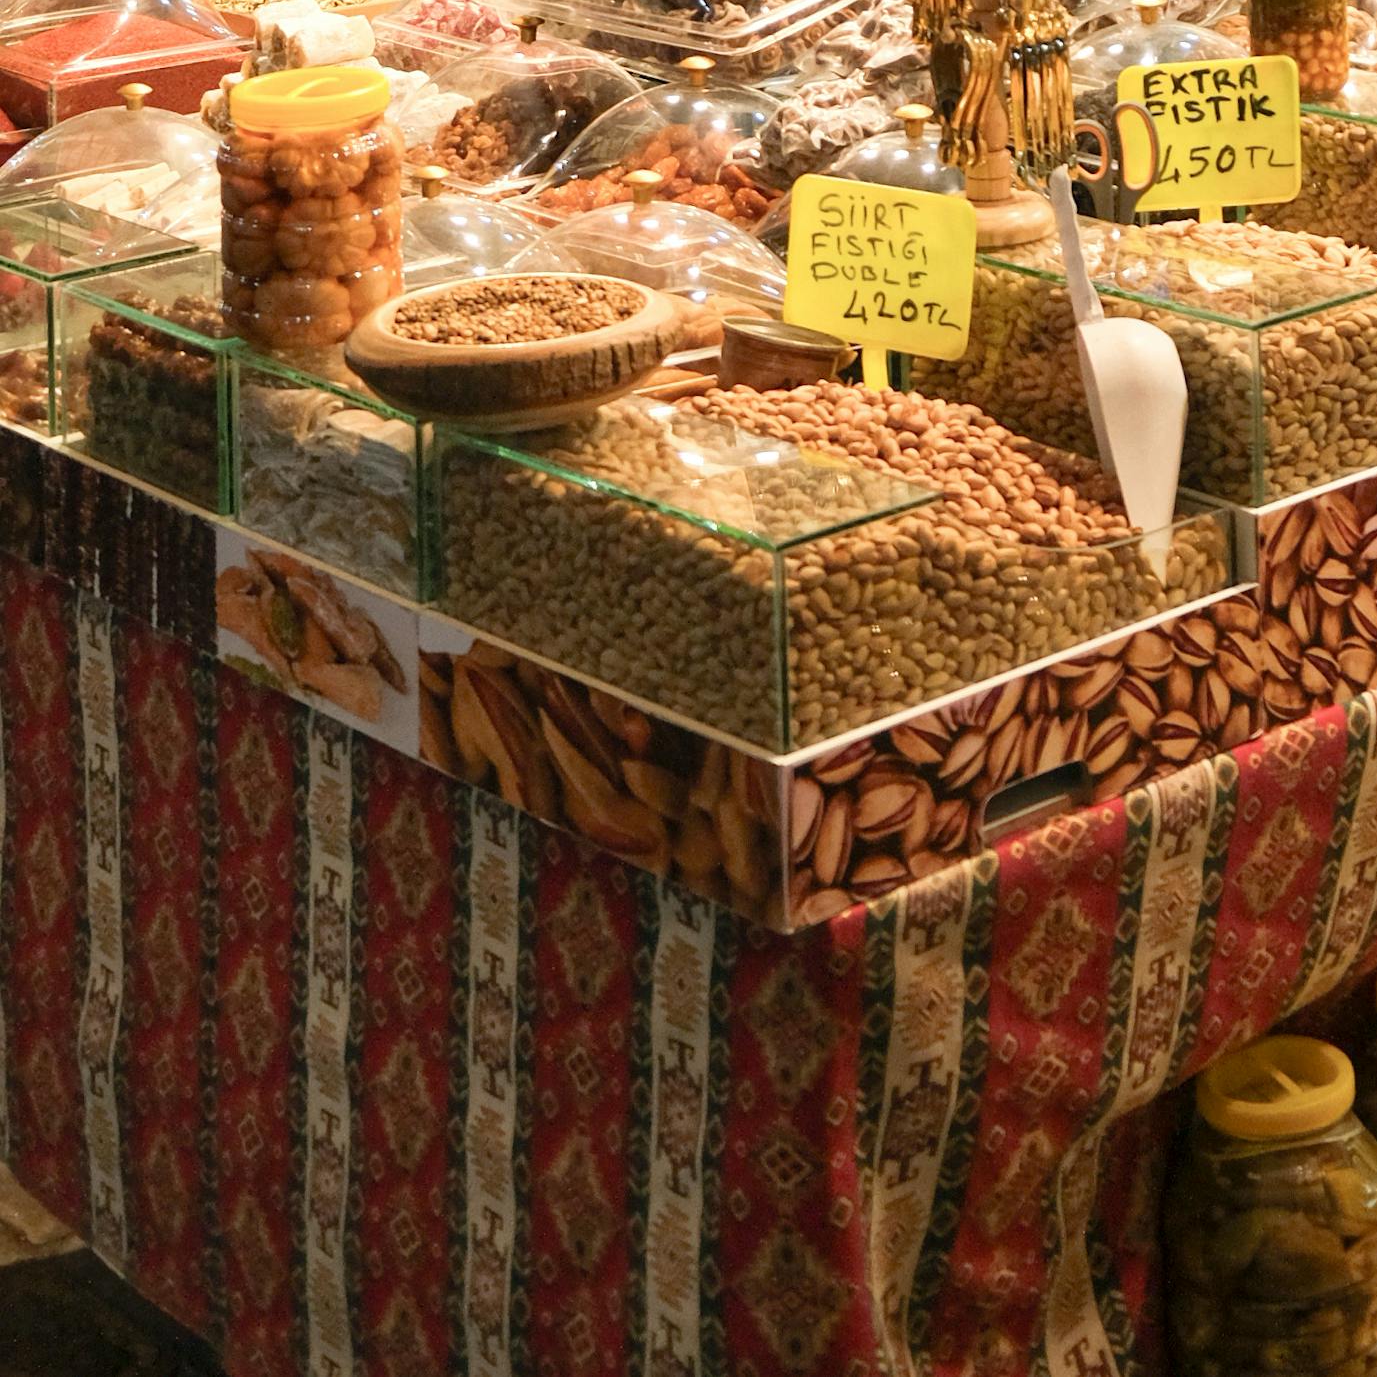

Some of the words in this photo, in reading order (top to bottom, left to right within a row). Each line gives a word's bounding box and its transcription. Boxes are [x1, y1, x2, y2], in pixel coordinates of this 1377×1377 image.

[1143, 63, 1258, 99] EXTRA
[1144, 93, 1276, 125] FISTIK
[811, 230, 928, 266] FISTIĞI
[810, 261, 928, 288] DUBLE
